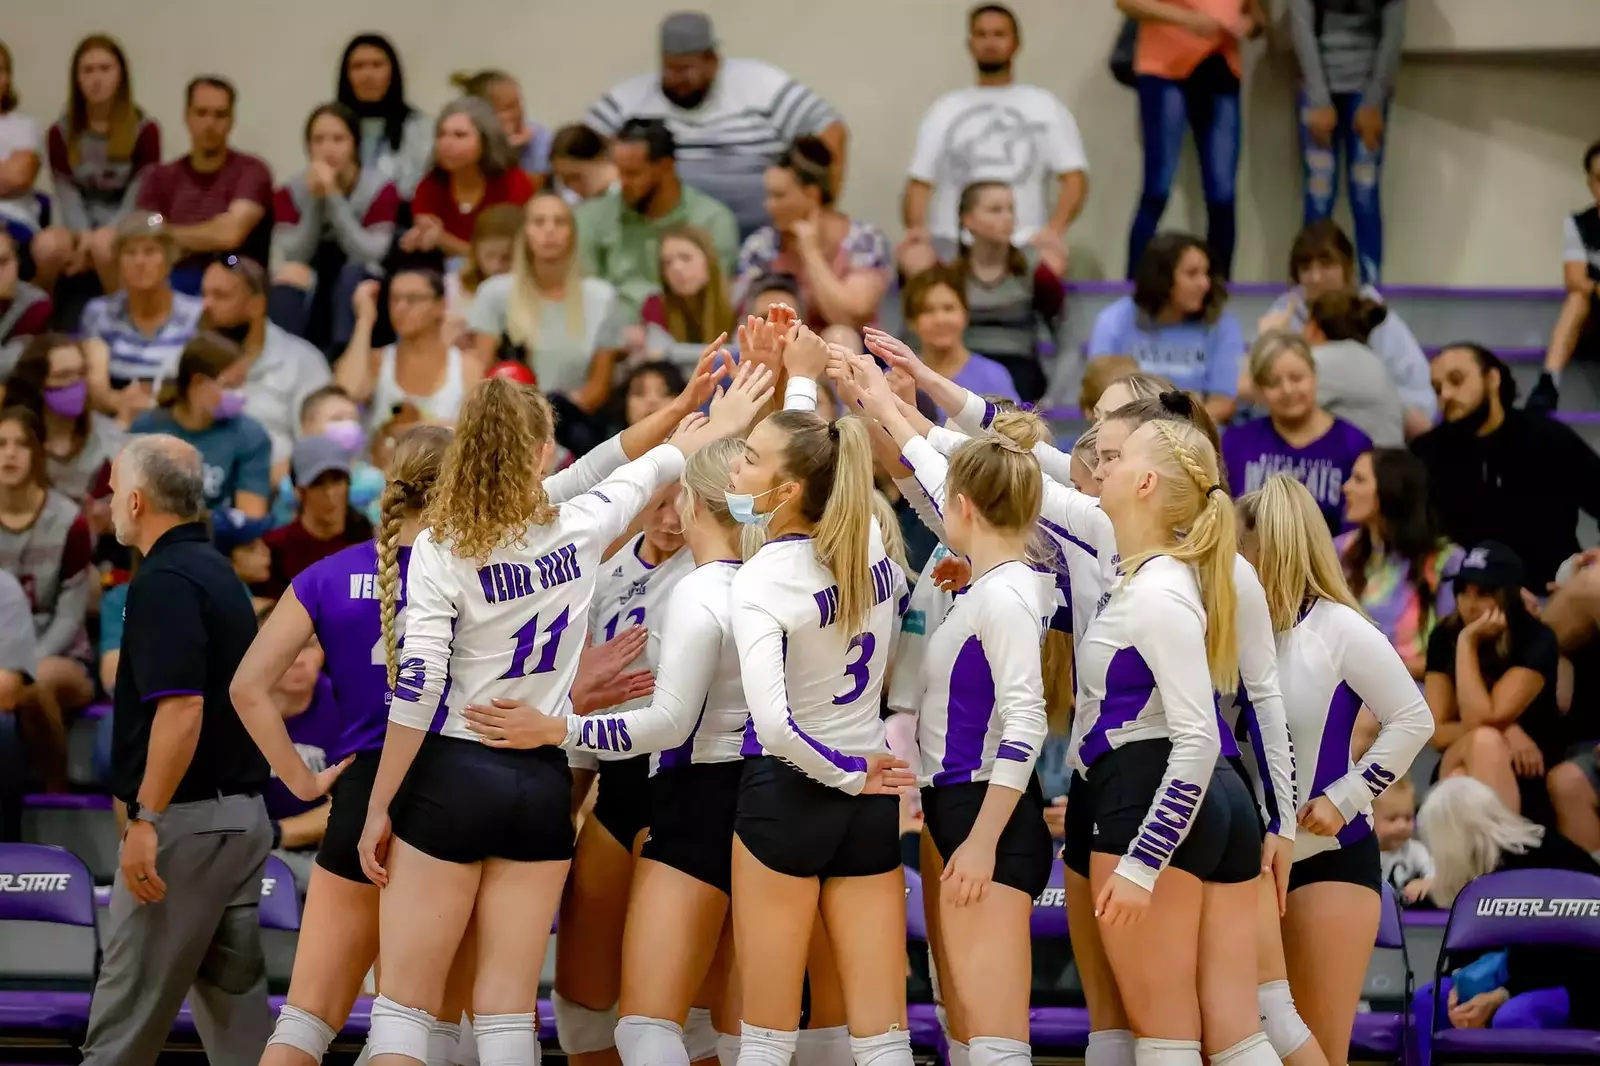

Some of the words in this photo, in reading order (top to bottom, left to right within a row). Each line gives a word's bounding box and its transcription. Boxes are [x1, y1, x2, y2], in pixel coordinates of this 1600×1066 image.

[477, 564, 535, 605] WEBER
[534, 543, 582, 590] STATE
[496, 604, 570, 681] 11
[831, 631, 876, 705] 3
[1130, 779, 1202, 871] WILDCATS
[16, 873, 72, 892] STATE
[1476, 898, 1544, 917] WEBER
[1545, 898, 1600, 917] STATE
